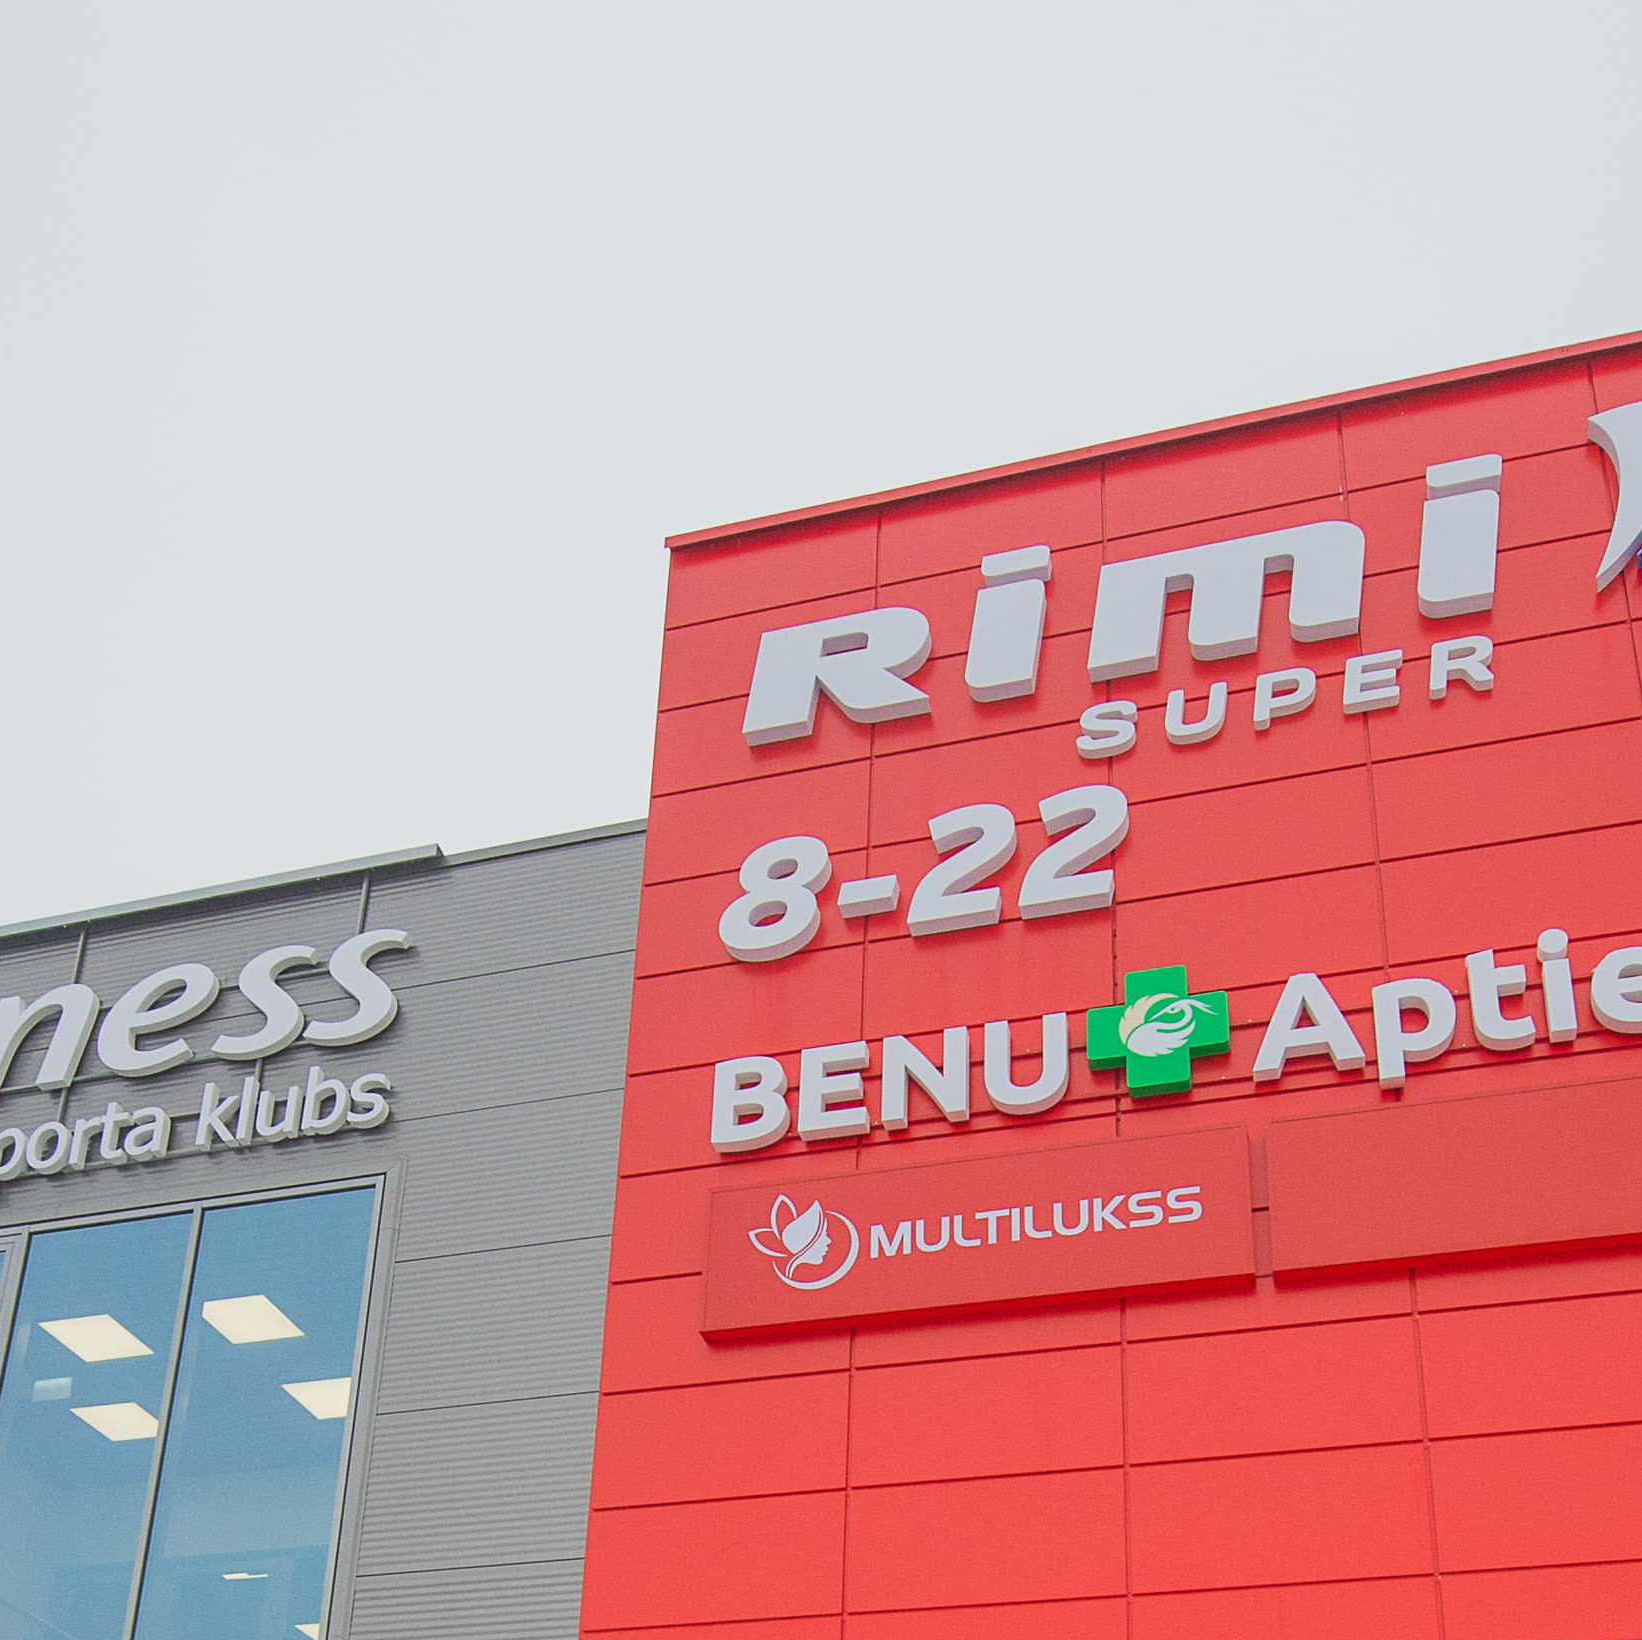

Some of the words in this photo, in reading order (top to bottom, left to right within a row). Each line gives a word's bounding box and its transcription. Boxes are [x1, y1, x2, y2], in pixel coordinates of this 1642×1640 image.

[1076, 634, 1497, 759] SUPER
[717, 783, 1130, 964] 8-22
[193, 1065, 393, 1152] klubs
[711, 1010, 1070, 1154] BENU
[868, 1182, 1205, 1260] MULTILUKSS
